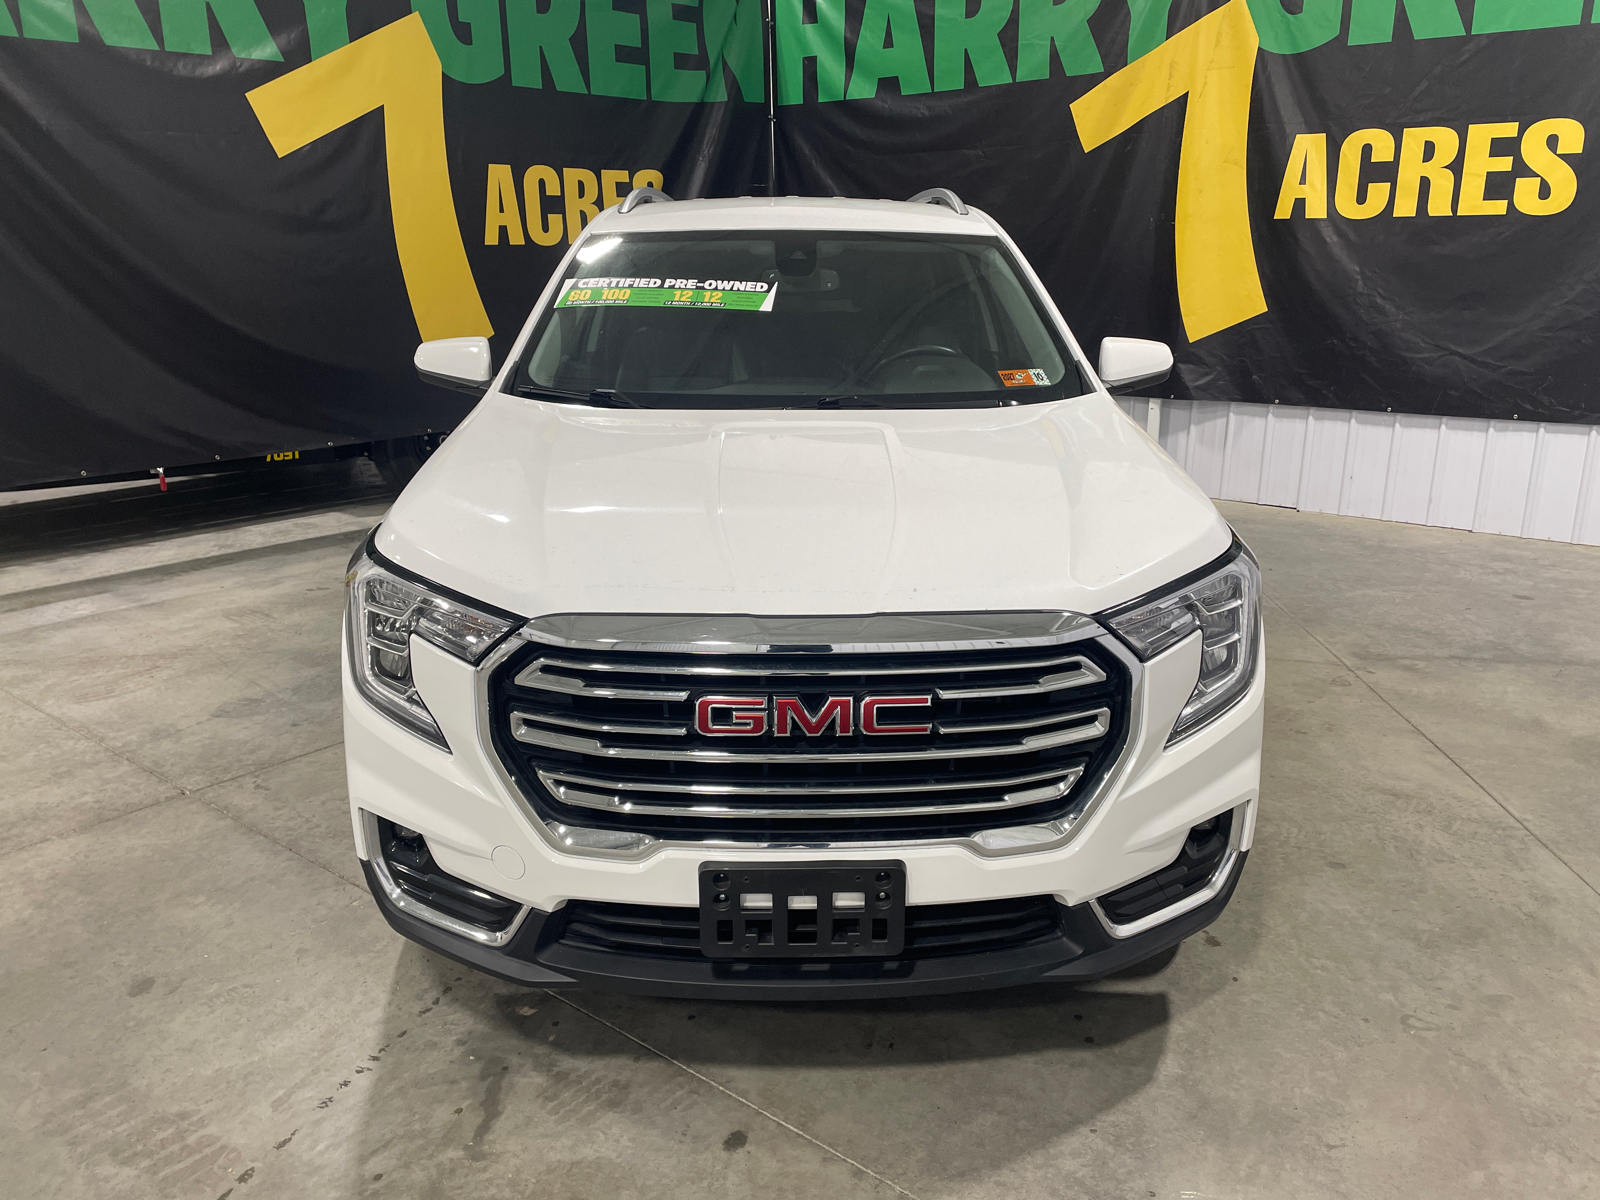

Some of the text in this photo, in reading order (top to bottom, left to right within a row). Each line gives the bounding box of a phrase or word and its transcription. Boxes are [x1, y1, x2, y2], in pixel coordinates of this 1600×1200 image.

[246, 11, 664, 342] 7 ACRE
[1069, 0, 1585, 342] 7 ACRES
[568, 289, 592, 300] 60
[601, 288, 631, 300] 100
[577, 278, 769, 292] CERTIFIED PRE-OWNED
[673, 290, 693, 302] 12
[703, 291, 723, 303] 12
[694, 695, 933, 737] GMC
